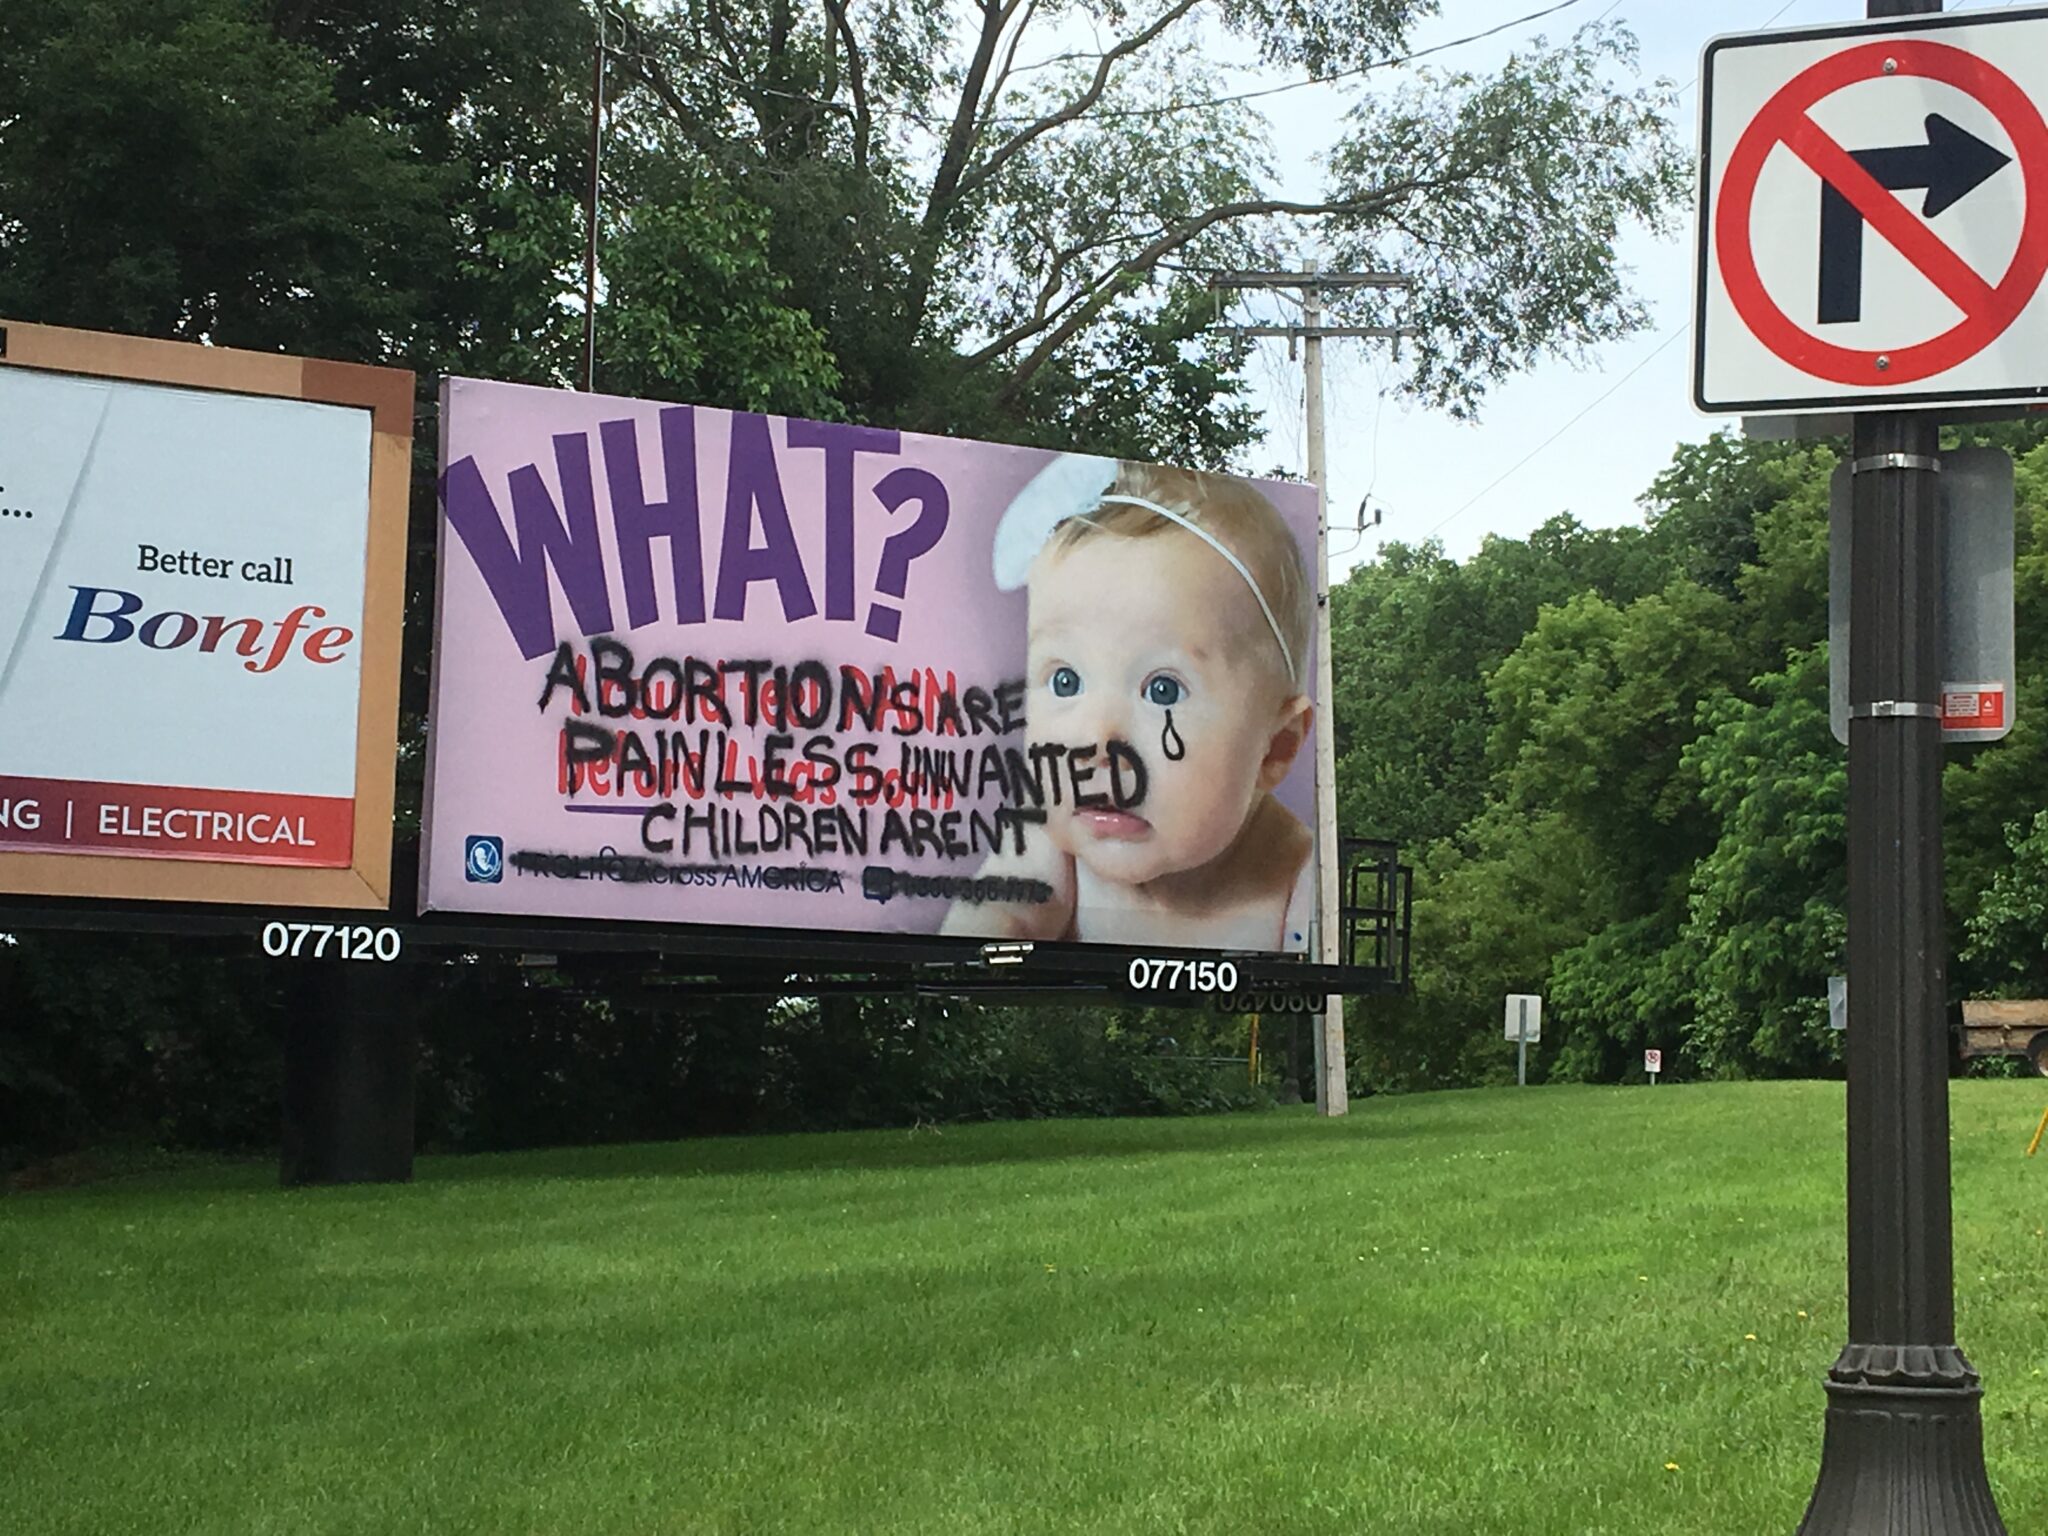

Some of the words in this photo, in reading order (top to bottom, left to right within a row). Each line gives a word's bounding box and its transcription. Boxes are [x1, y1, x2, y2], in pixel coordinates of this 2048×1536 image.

[438, 405, 950, 660] WHAT?
[137, 544, 234, 581] Better
[240, 557, 294, 585] call
[53, 584, 355, 674] Bonfe
[537, 636, 924, 737] ABORTIONS
[937, 678, 1028, 737] ARE
[901, 740, 1148, 809] UNWANTED
[99, 804, 316, 846] ELECTRICAL
[641, 801, 868, 859] CHILDREN
[880, 801, 1047, 859] ARENT
[262, 922, 401, 962] 077120
[1128, 957, 1238, 992] 077150
